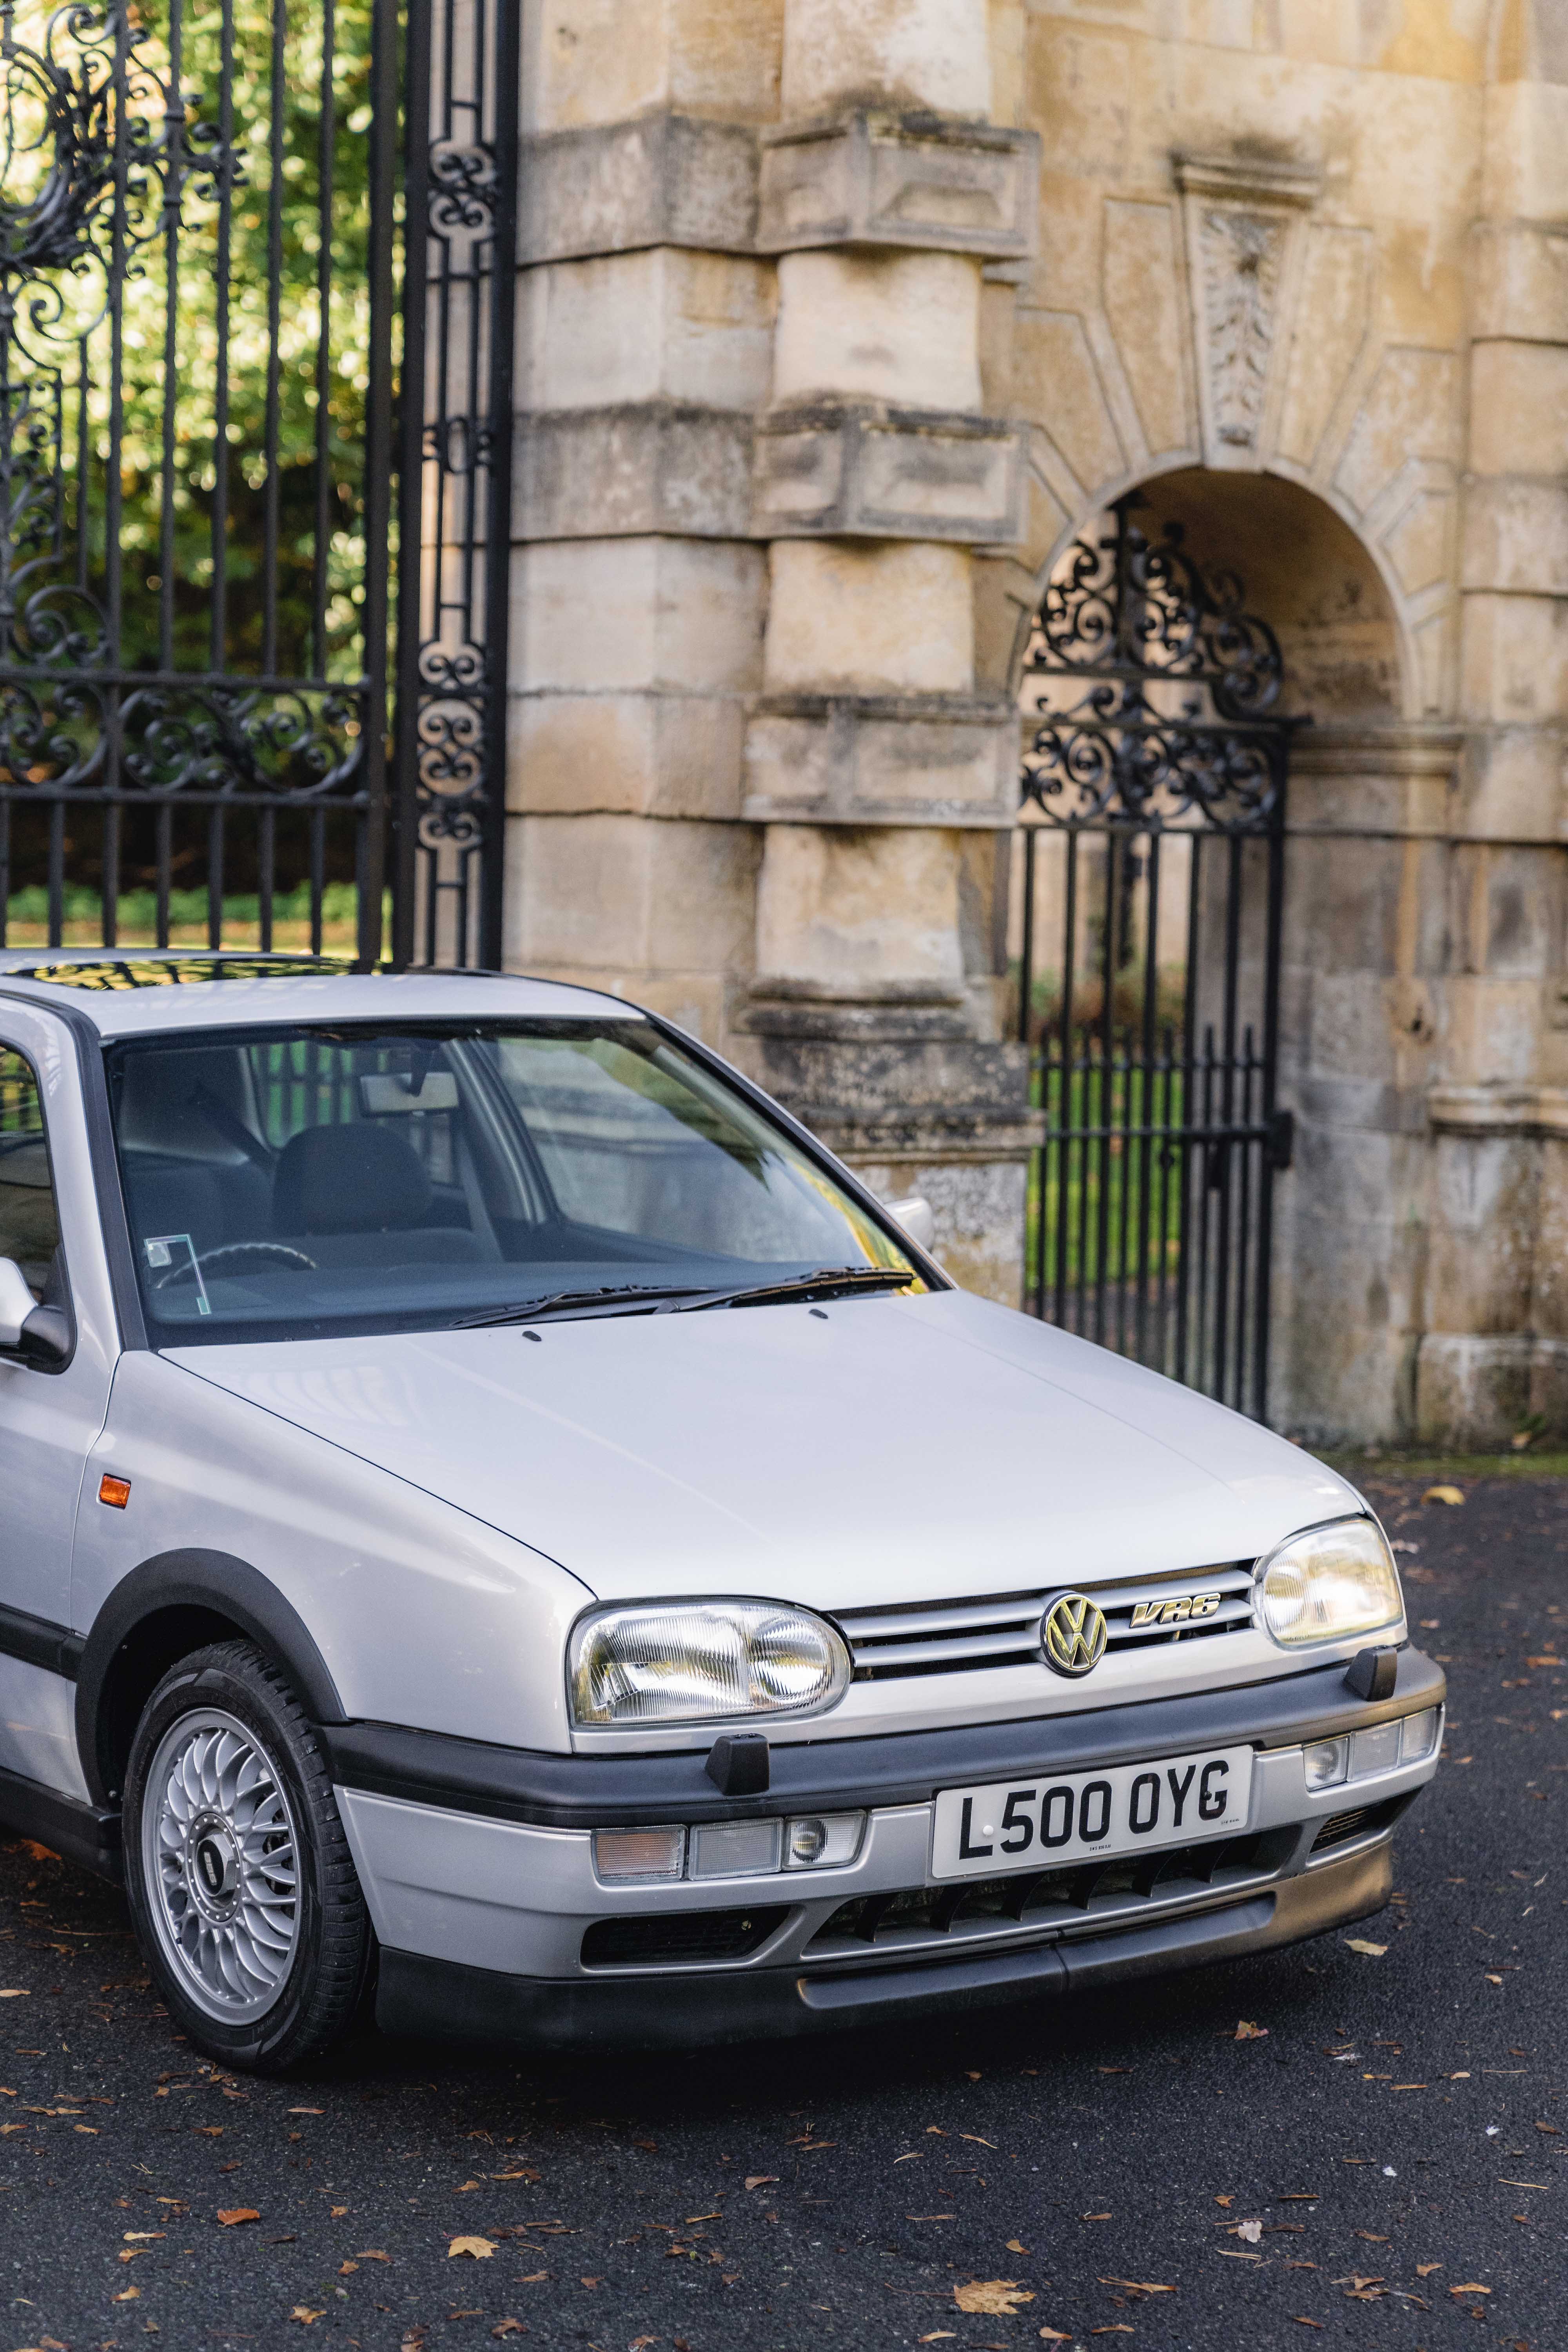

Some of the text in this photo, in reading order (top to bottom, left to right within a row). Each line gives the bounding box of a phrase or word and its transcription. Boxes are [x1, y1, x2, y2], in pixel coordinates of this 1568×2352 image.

[1129, 1592, 1221, 1628] VR6
[960, 1760, 1229, 1860] L500 OYG
